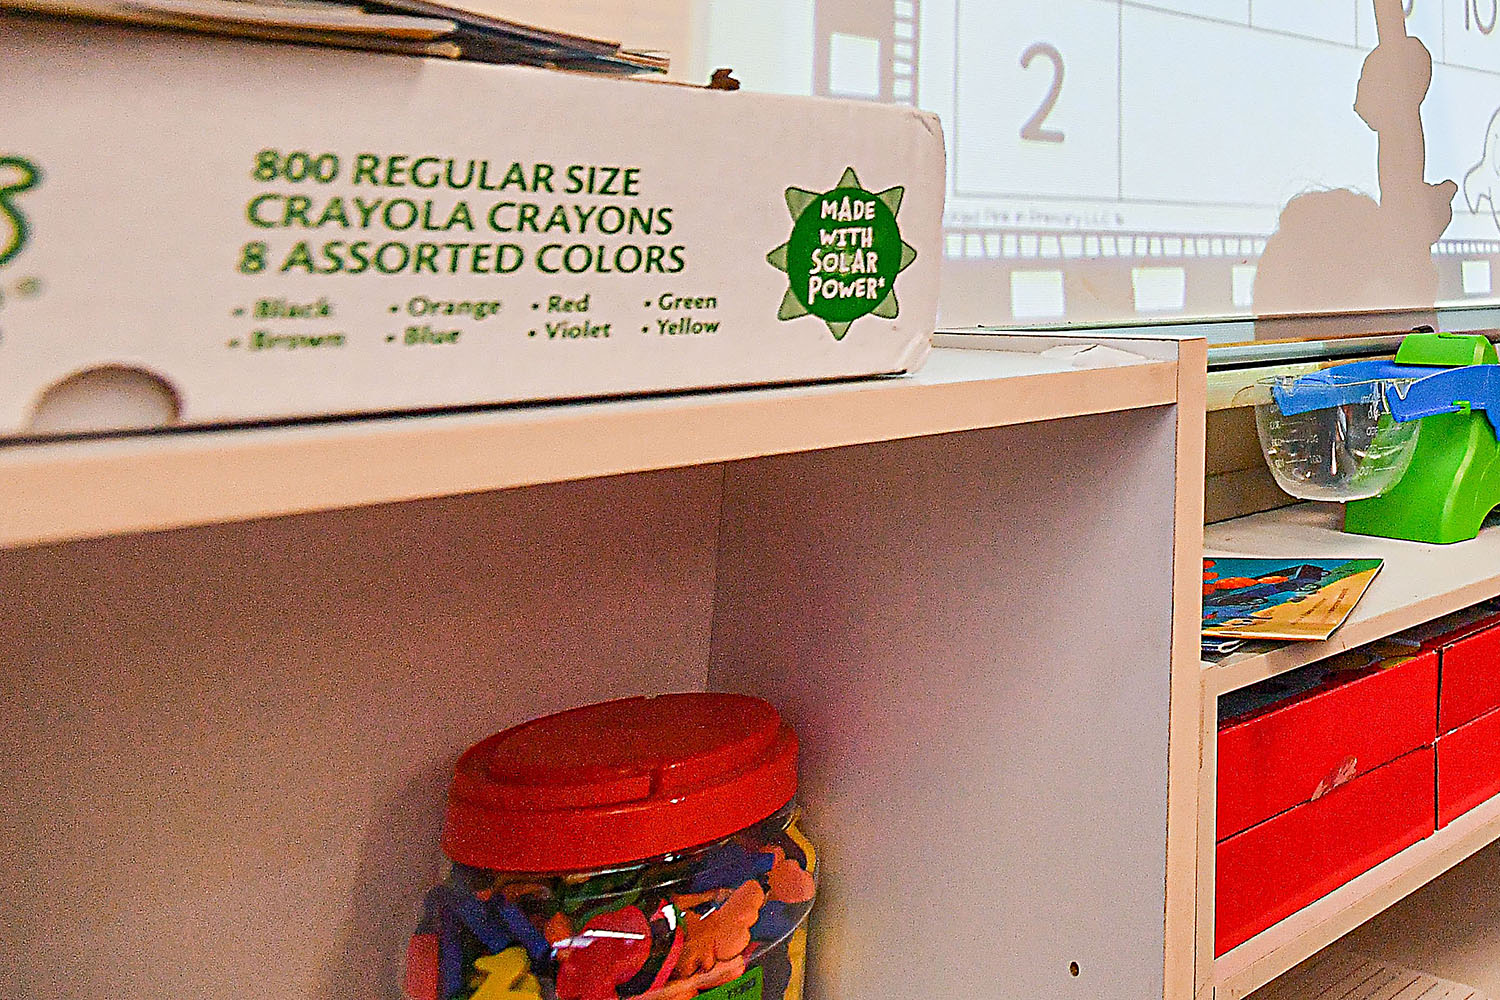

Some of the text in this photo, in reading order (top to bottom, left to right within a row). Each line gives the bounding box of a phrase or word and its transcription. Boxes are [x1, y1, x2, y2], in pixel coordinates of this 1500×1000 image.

[1020, 42, 1066, 143] 2
[253, 149, 641, 197] 800 REGULAR SIZE
[246, 193, 674, 236] CRAYOLA CRAYONS
[820, 195, 877, 222] MADE
[819, 226, 873, 249] WITH
[239, 239, 687, 275] 8 ASSORTED COLORS
[808, 248, 879, 275] SOLAR
[407, 296, 501, 321] Orange
[547, 293, 591, 313] Red
[657, 293, 718, 311] Green
[545, 320, 611, 340] Violet
[657, 317, 721, 336] Yellow
